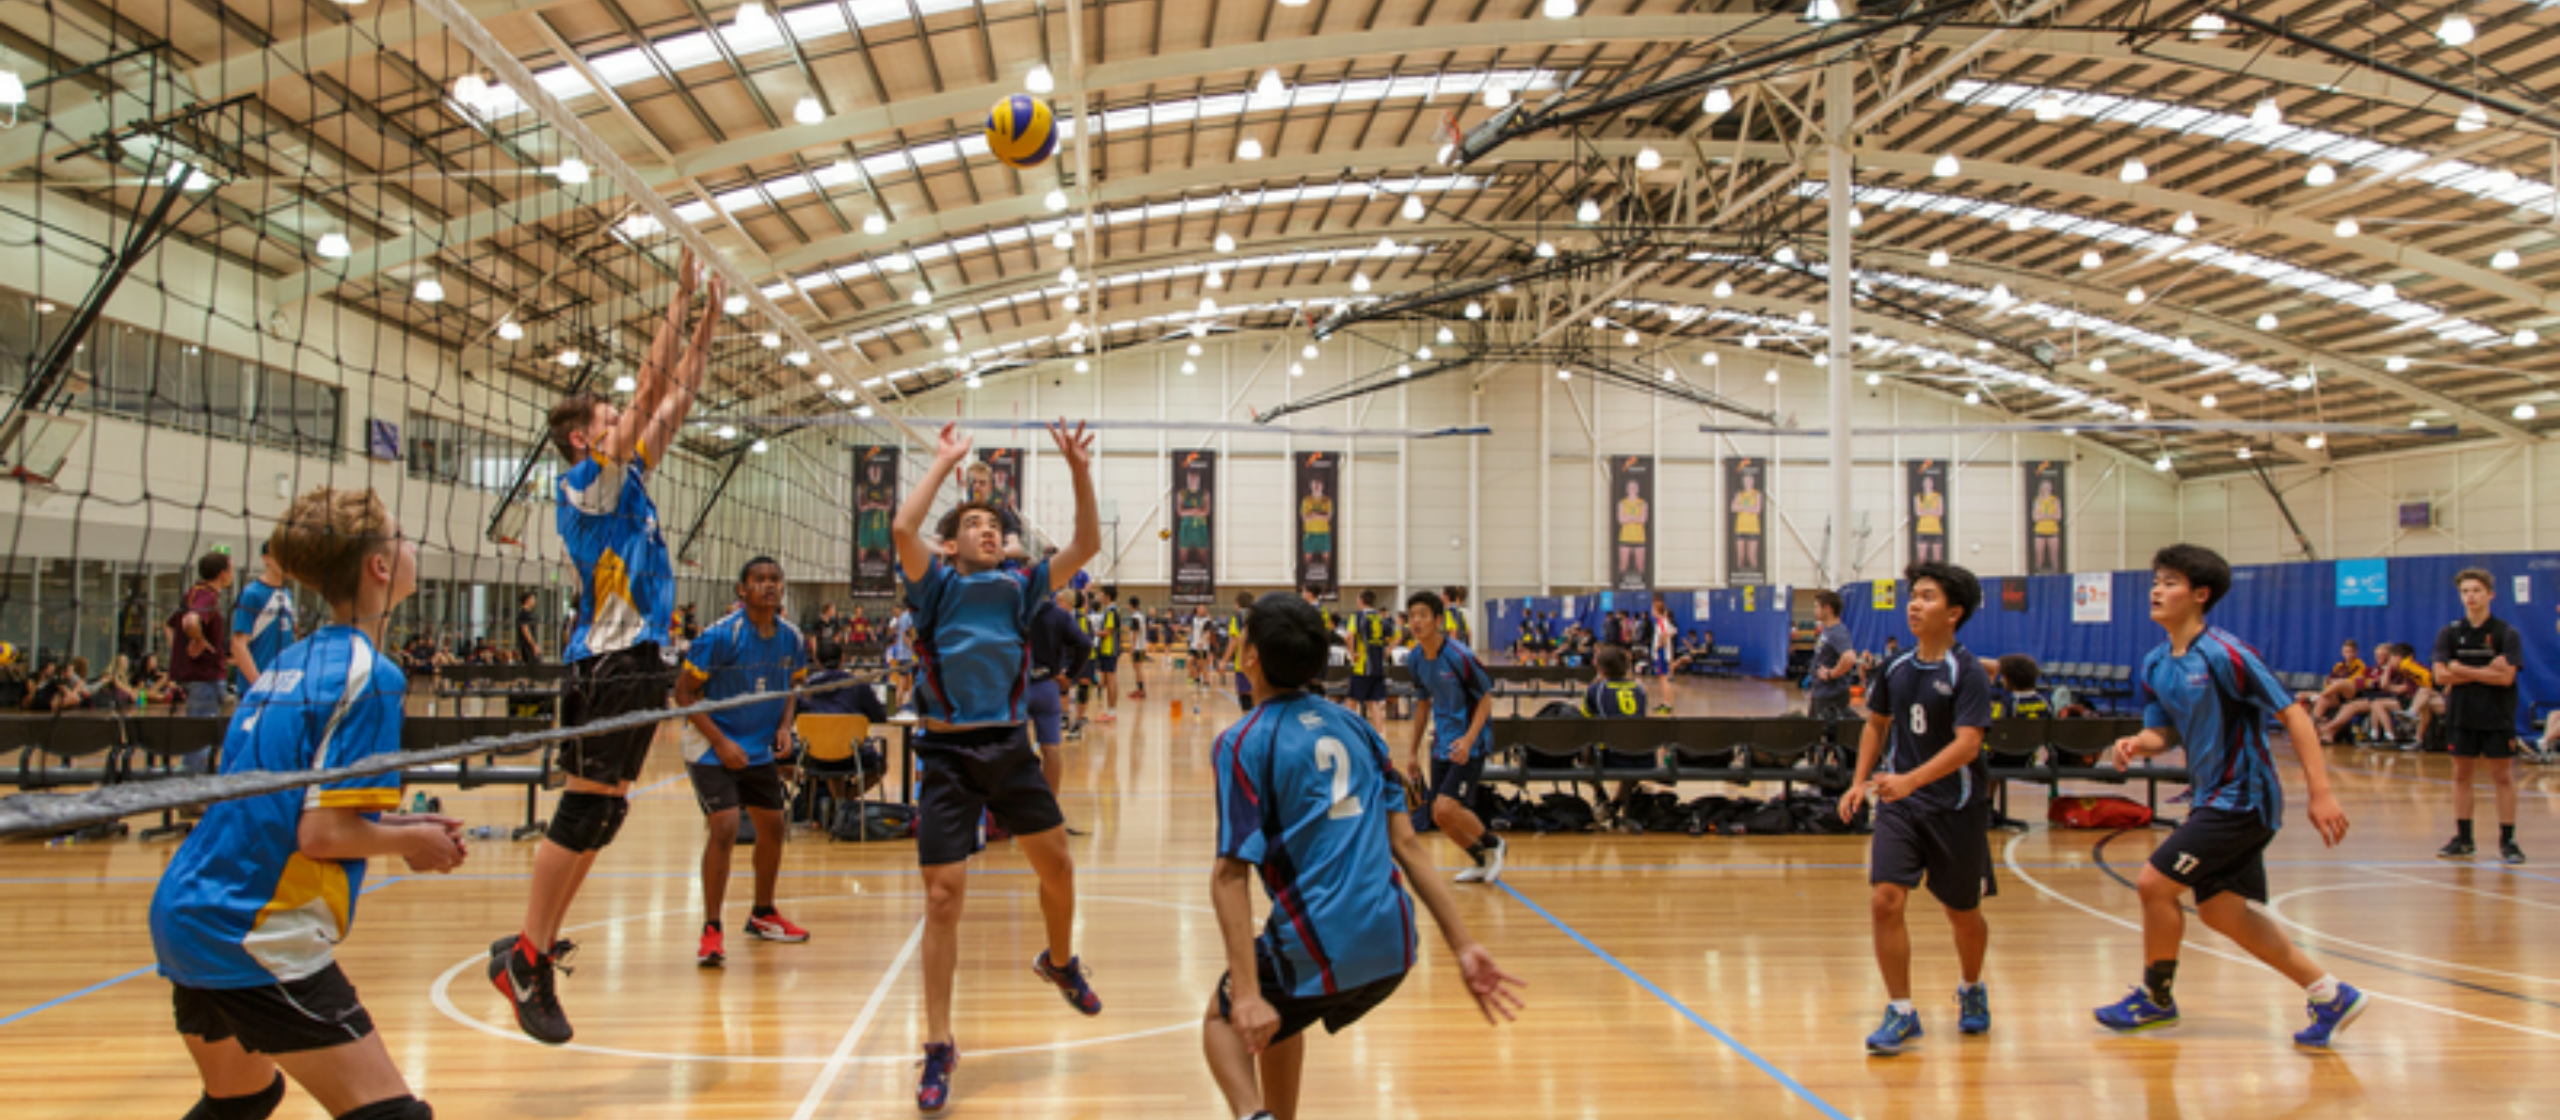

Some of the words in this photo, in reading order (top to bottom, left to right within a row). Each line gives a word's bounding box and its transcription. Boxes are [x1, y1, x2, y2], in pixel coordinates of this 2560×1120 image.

[1616, 689, 1637, 716] 6
[1910, 702, 1927, 734] 8
[1314, 735, 1363, 820] 2
[2173, 852, 2199, 875] 17
